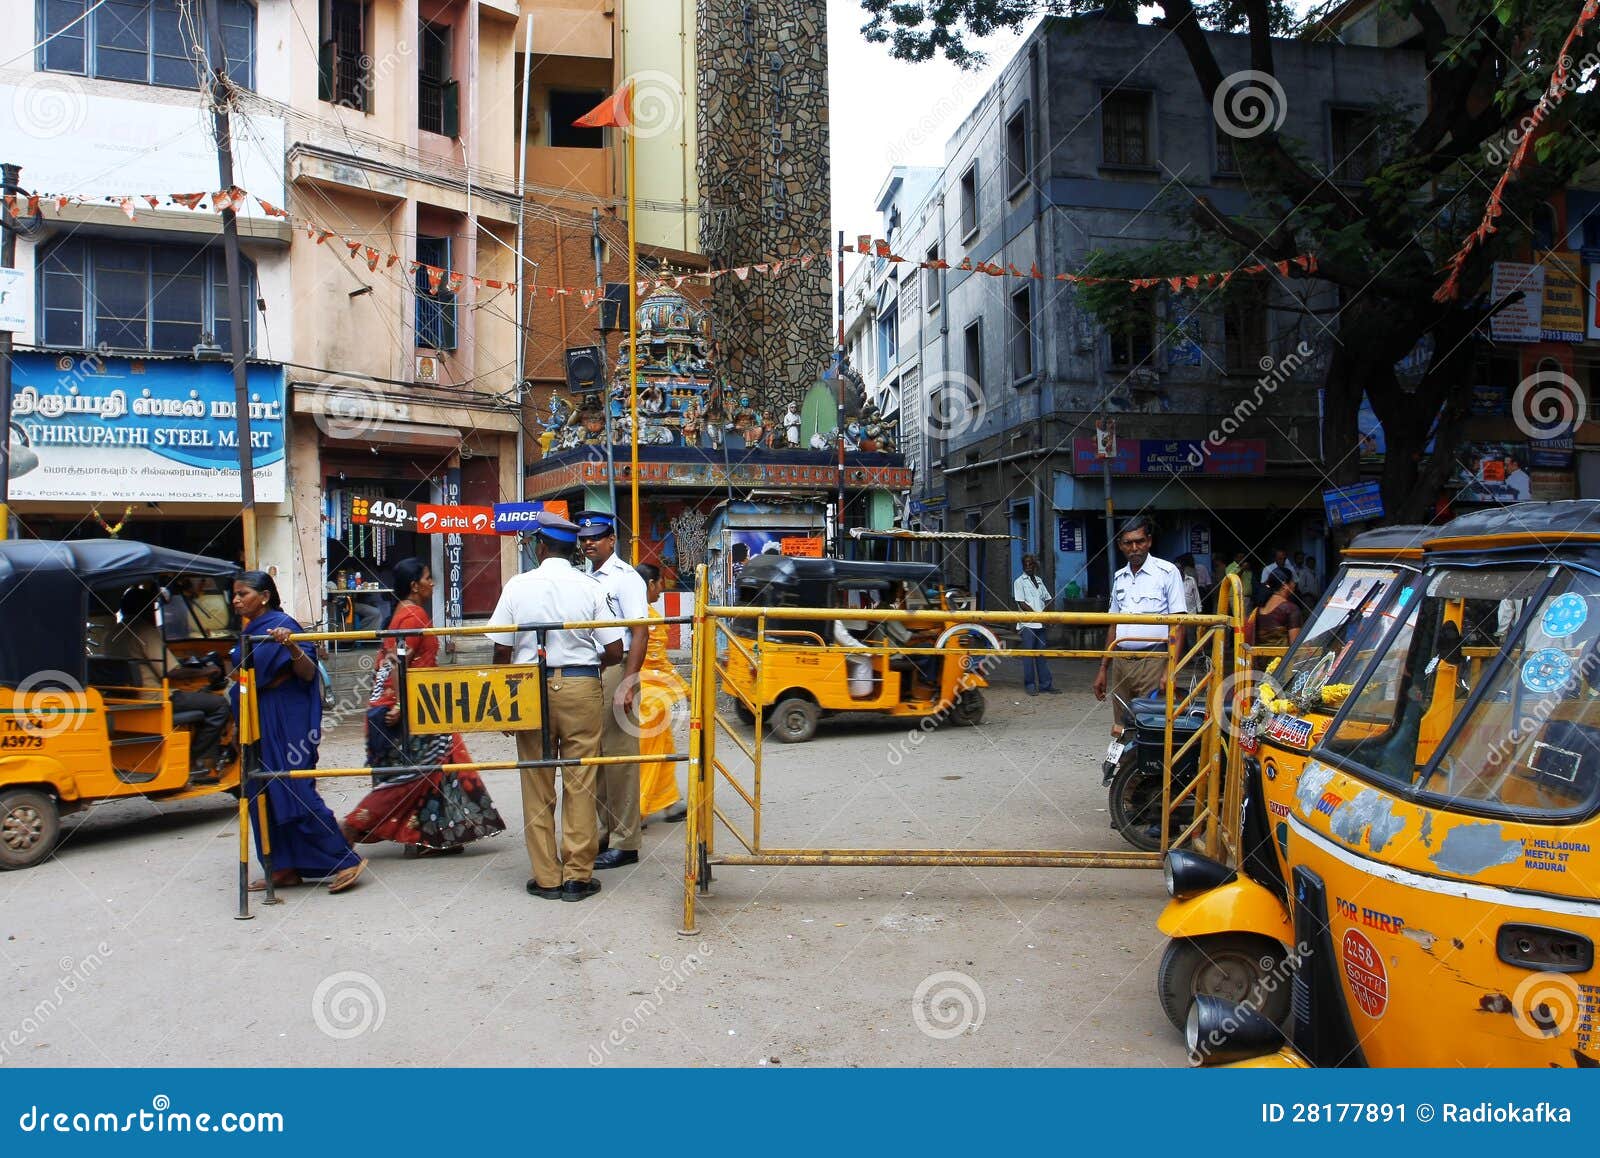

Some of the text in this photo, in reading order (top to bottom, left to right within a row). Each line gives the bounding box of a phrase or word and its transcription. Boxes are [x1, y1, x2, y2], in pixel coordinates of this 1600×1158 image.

[10, 386, 128, 419] திருப்பதி
[133, 388, 206, 417] ஸ்டீல்
[28, 424, 272, 448] THIRUPATHI STEEL MRT
[370, 501, 407, 522] 40p
[440, 515, 469, 528] airtel
[417, 681, 522, 725] NHAI
[1525, 849, 1569, 861] MEETU ST
[1525, 860, 1566, 872] MADURAI
[1336, 896, 1358, 922] FOR
[1346, 937, 1374, 967] 2258
[1347, 963, 1382, 990] SOUTH
